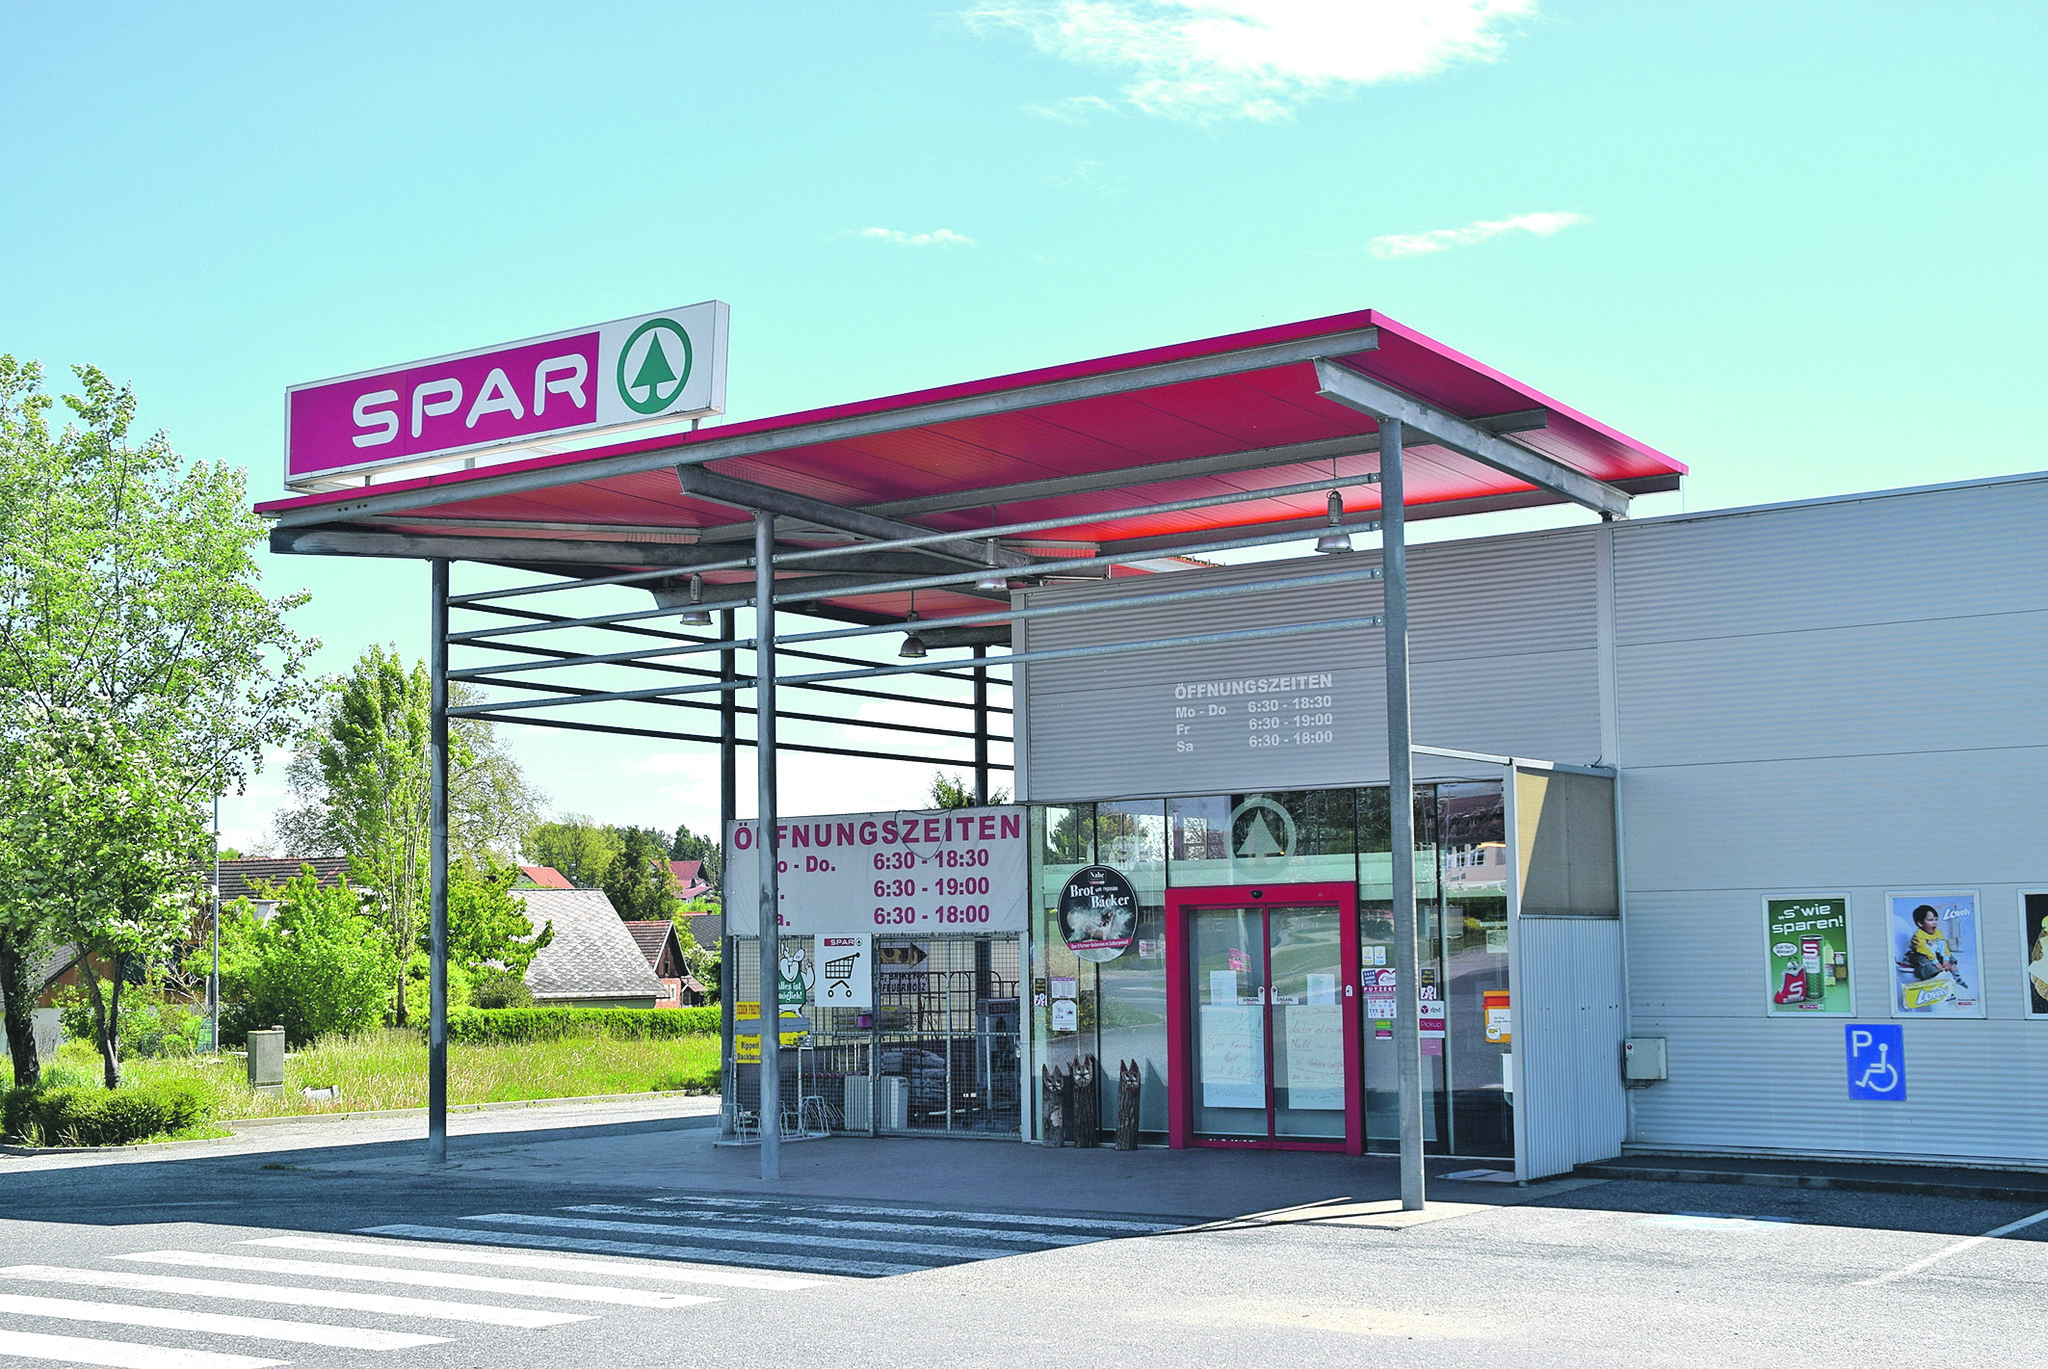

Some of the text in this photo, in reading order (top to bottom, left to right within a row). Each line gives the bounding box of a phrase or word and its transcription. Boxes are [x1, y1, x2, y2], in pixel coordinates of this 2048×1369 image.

[352, 353, 588, 448] SPAR
[1174, 673, 1333, 699] ÖFFNUNGSZEITEN
[1175, 707, 1196, 719] Mo
[1208, 704, 1227, 716] Do
[1248, 699, 1279, 713] 6:30
[1292, 695, 1332, 710] 18:30
[1176, 724, 1190, 735] Fr
[1249, 716, 1280, 730] 6:30
[1293, 713, 1333, 727] 19:00
[1176, 741, 1194, 752] Sa
[1249, 734, 1280, 748] 6:30
[1293, 730, 1333, 745] 18:00
[734, 813, 1020, 851] ÖFNUNGSZEITEN
[805, 856, 836, 872] Do.
[873, 852, 915, 870] 6:30
[935, 849, 989, 868] 18:30
[874, 879, 915, 897] 6:30
[935, 877, 990, 895] 19:00
[1069, 884, 1095, 897] Brot
[1091, 894, 1130, 909] Bäcker
[1800, 903, 1831, 917] wie
[874, 906, 916, 925] 6:30
[935, 905, 990, 924] 18:00
[1772, 915, 1844, 935] sparen!
[830, 939, 855, 947] SPAR
[1421, 1020, 1442, 1028] Pickup
[1852, 1030, 1872, 1058] P
